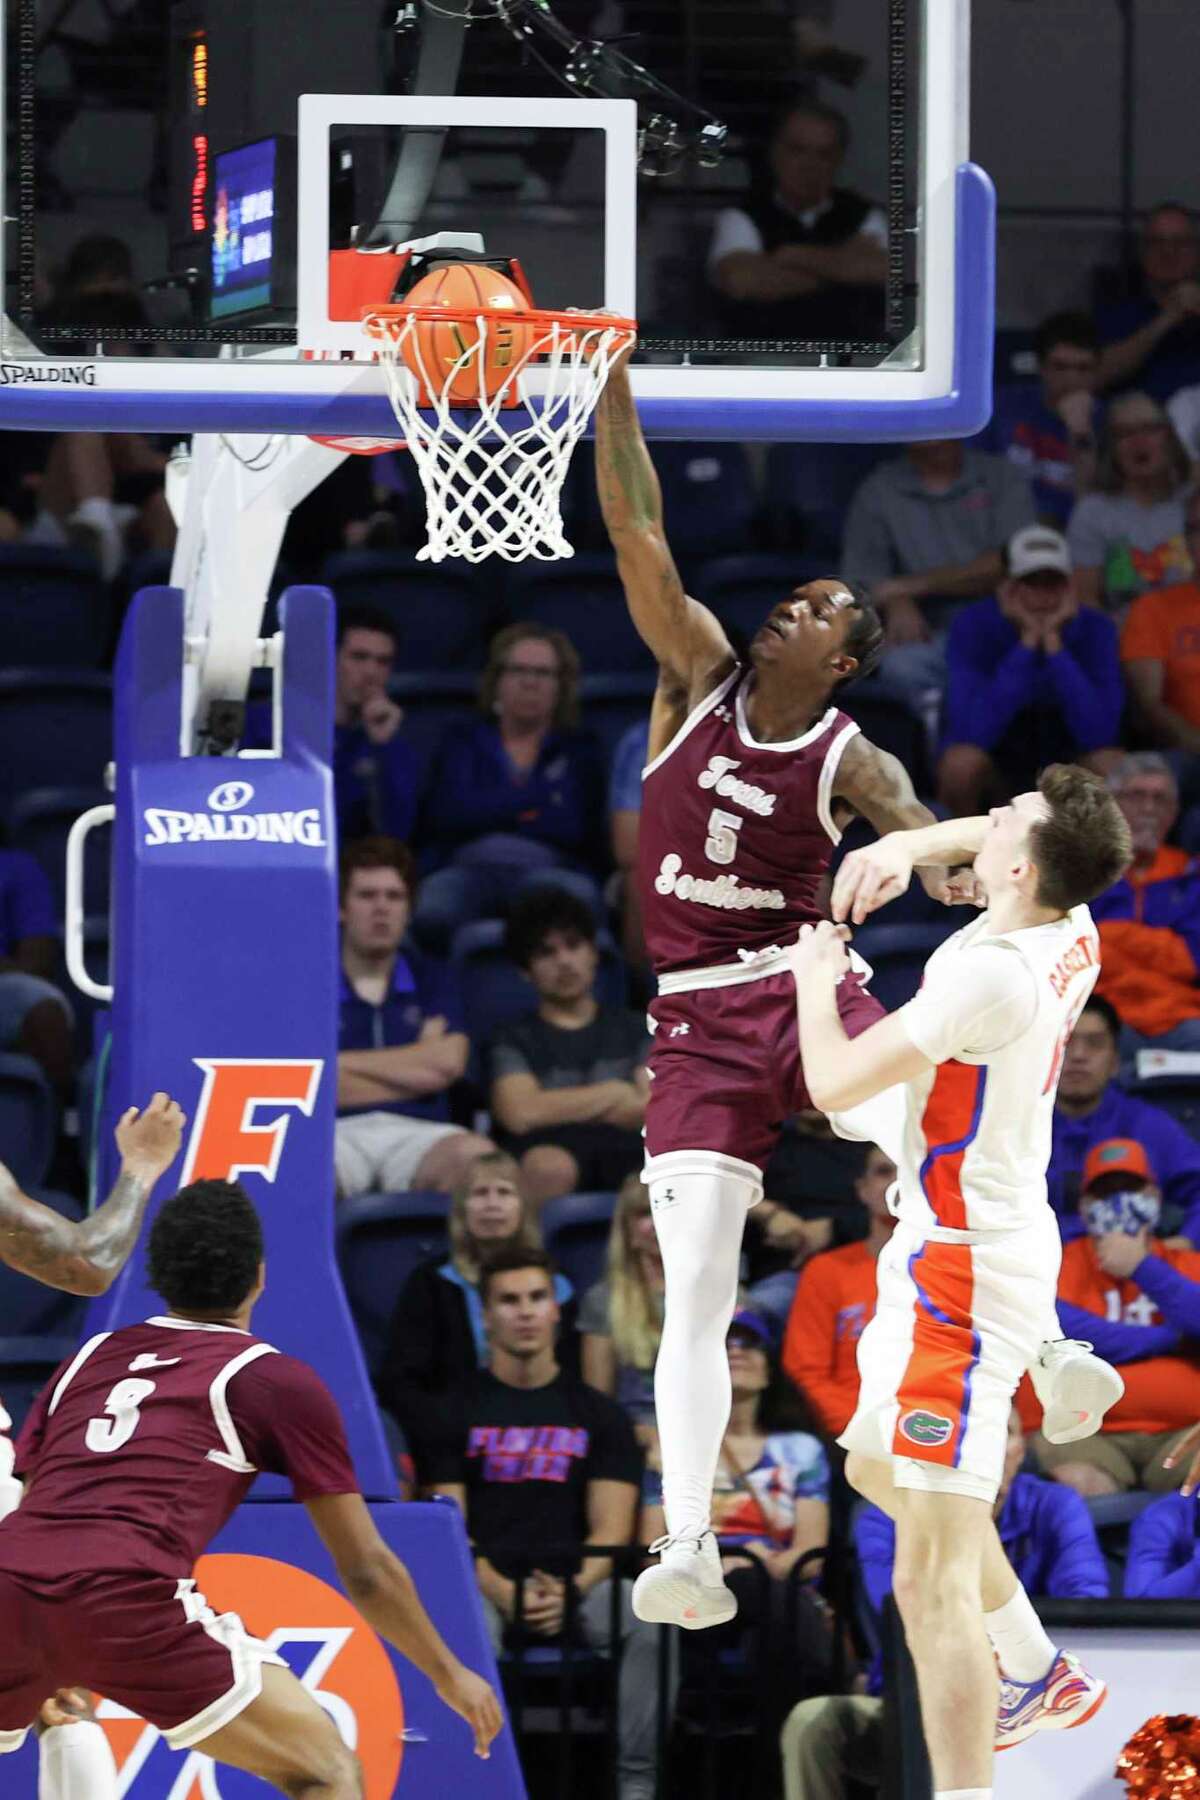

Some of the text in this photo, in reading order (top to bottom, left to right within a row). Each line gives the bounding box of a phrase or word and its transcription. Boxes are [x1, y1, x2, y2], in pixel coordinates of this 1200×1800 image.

[0, 363, 97, 386] SPALDING
[697, 755, 777, 817] Texas
[143, 808, 327, 847] SPALDING
[704, 807, 744, 865] 5
[654, 853, 787, 911] Southern
[178, 1057, 325, 1189] F
[84, 1377, 157, 1453] 3
